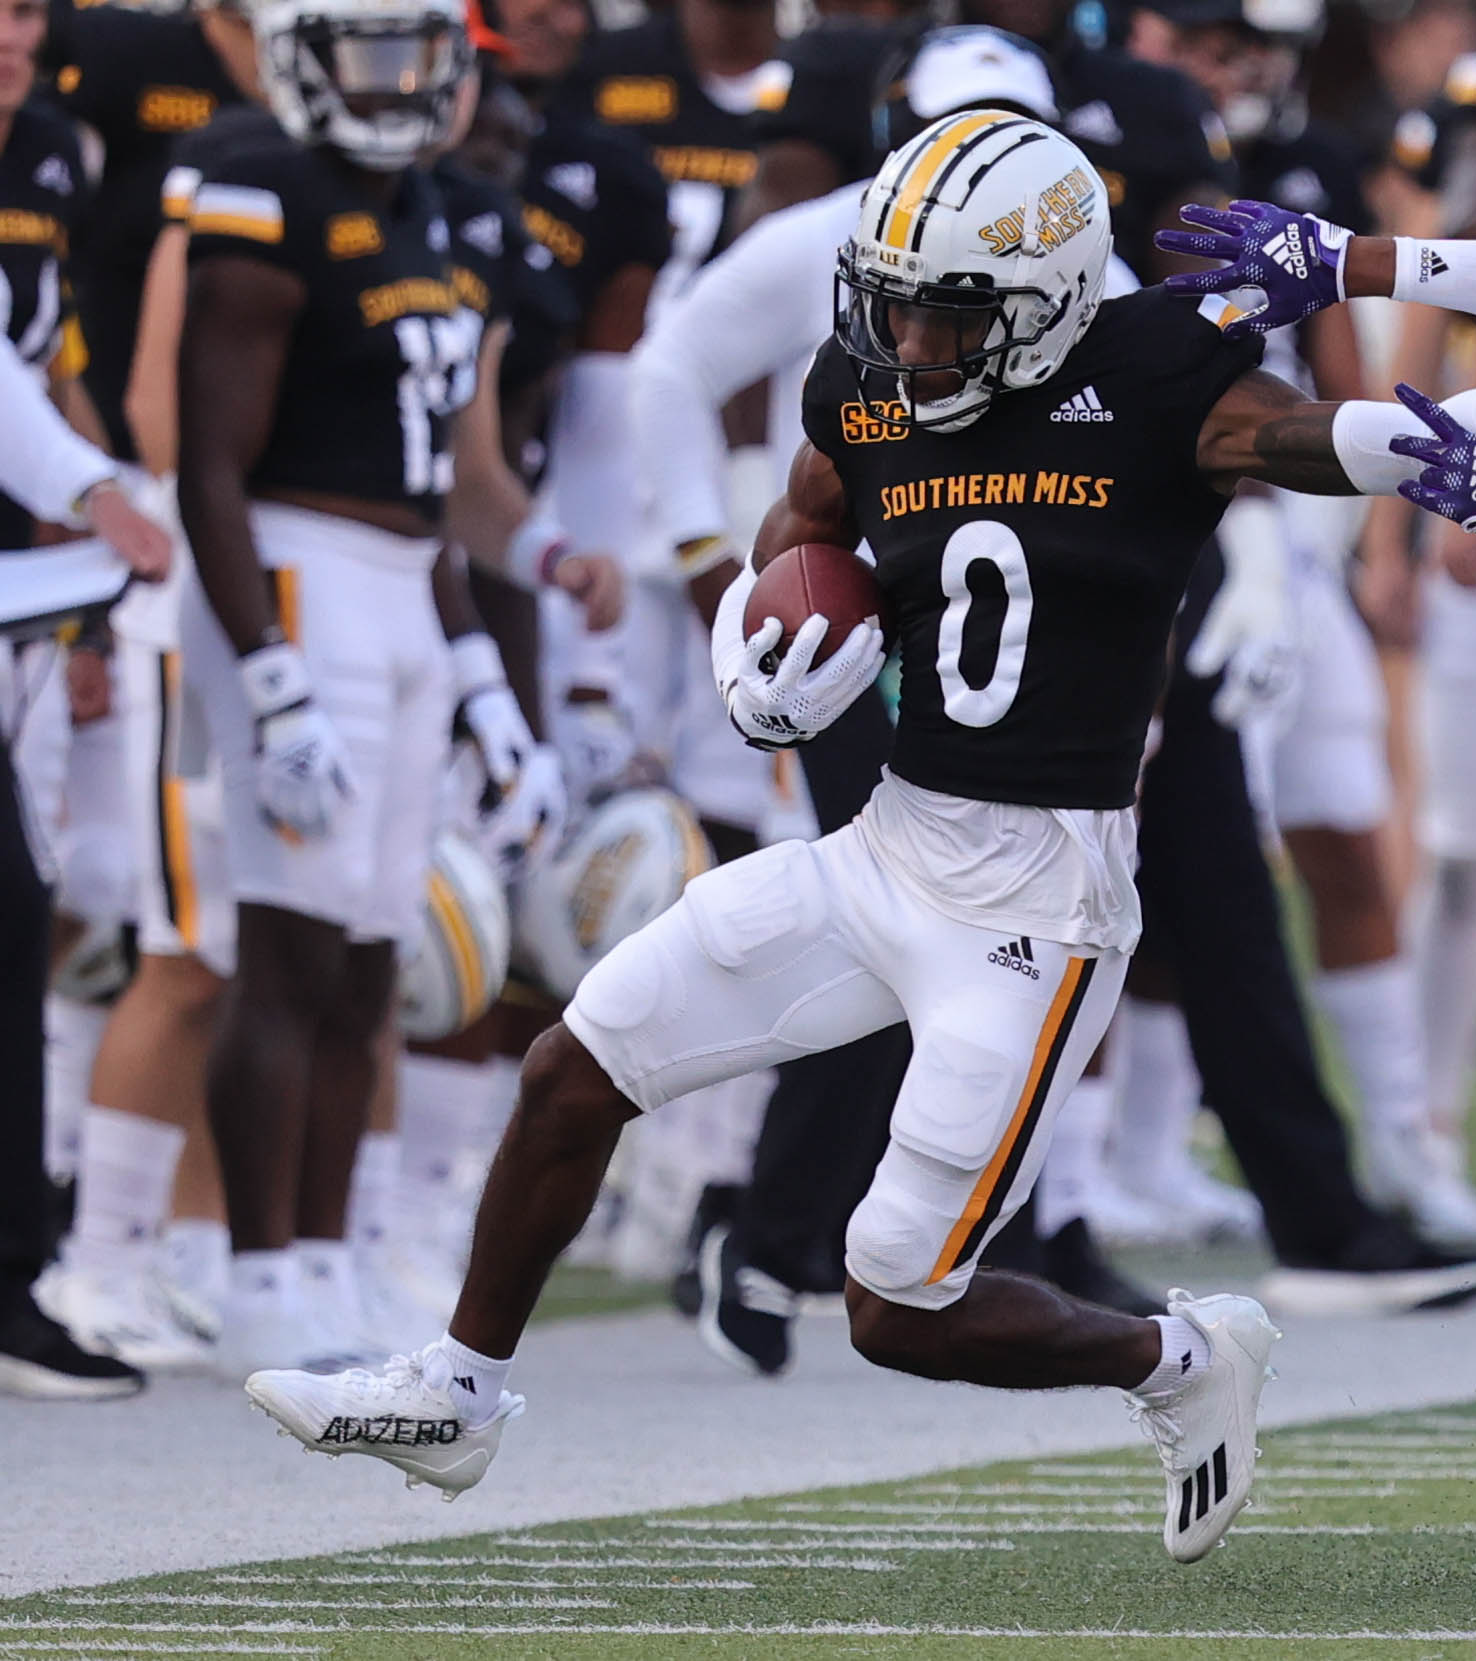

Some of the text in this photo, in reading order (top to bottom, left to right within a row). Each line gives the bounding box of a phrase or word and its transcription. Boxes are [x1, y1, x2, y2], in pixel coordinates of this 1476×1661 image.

[1038, 206, 1086, 253] MISS
[1286, 222, 1308, 280] adidas
[1049, 407, 1114, 423] adidas
[880, 470, 1114, 521] SOUTHERN MISS
[936, 519, 1034, 729] 0
[987, 952, 1041, 981] adidas
[315, 1414, 461, 1447] ADIZERO
